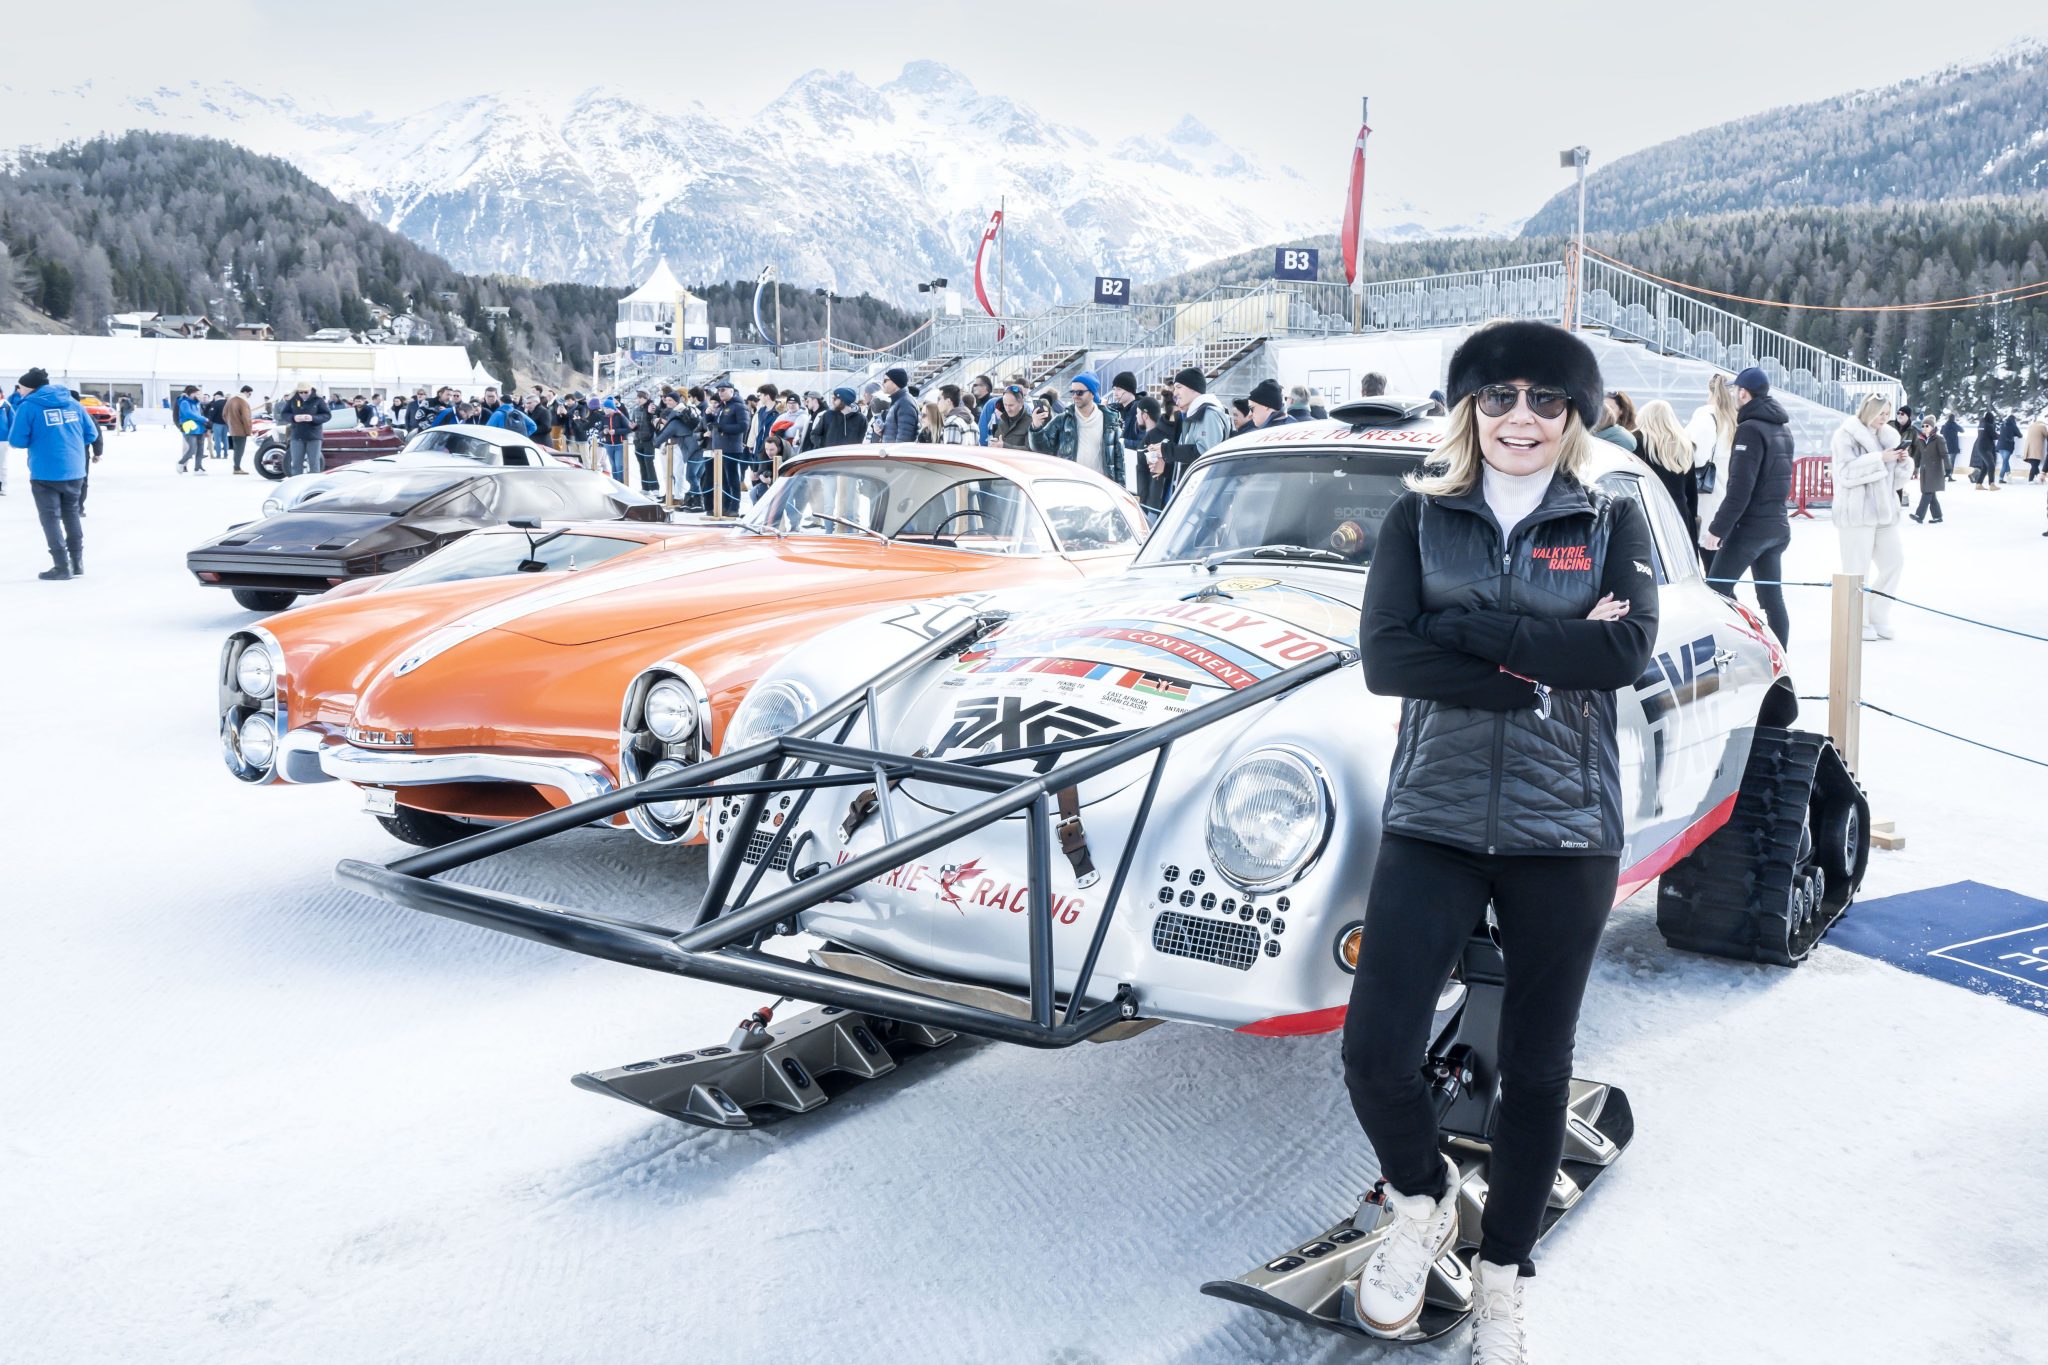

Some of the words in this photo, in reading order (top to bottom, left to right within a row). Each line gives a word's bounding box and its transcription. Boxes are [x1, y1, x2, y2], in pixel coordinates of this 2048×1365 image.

[1284, 251, 1310, 271] B3
[1102, 279, 1123, 296] B2
[694, 338, 704, 346] A2
[1256, 430, 1323, 443] RACE
[1323, 430, 1351, 440] TO
[1358, 430, 1445, 444] RESCU
[1532, 545, 1587, 559] VALKYRIE
[1548, 558, 1592, 571] RACING
[1124, 603, 1267, 632] RALLY
[1260, 629, 1328, 661] TO
[1128, 632, 1253, 687] CONTINENT
[1101, 695, 1122, 704] SAFARI
[1122, 701, 1148, 712] CLASSIC
[1107, 691, 1122, 699] EAST
[1123, 695, 1149, 706] AFRICAN
[969, 877, 1085, 925] RACNG
